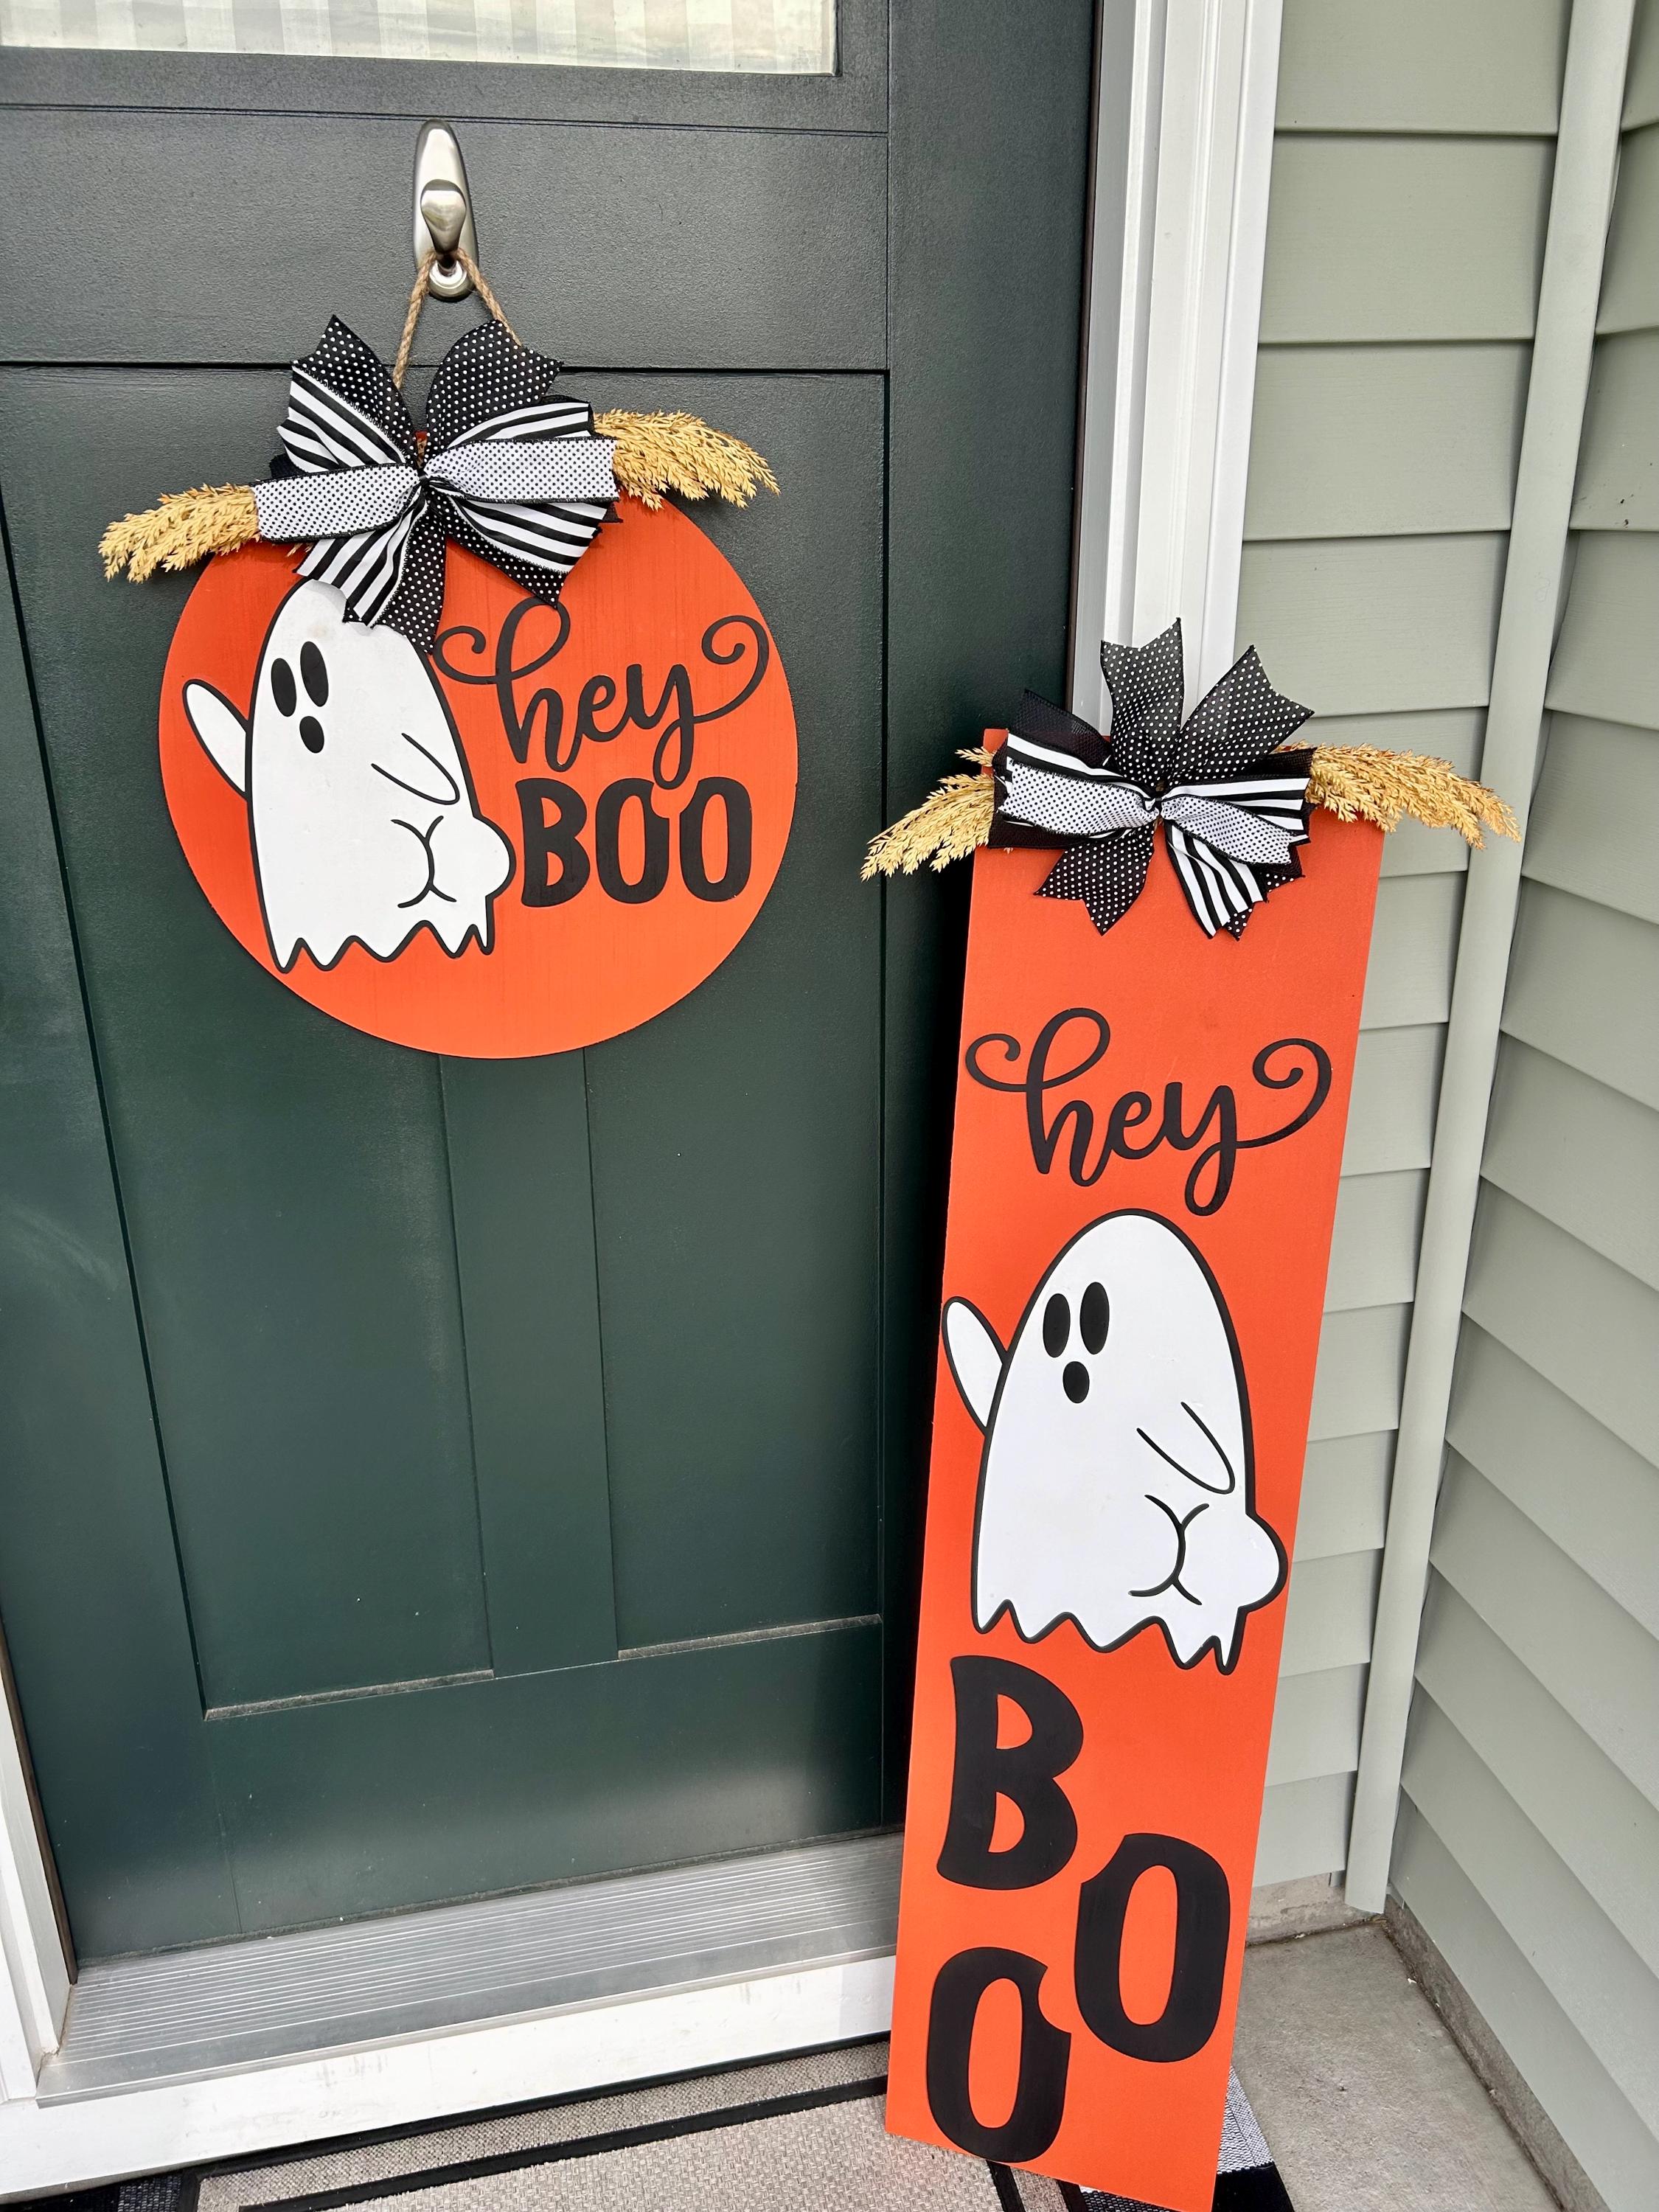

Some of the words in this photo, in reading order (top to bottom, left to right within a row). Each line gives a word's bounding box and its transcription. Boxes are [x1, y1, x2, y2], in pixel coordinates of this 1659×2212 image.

[434, 597, 769, 790] hey
[515, 776, 752, 908] BOO
[965, 1007, 1332, 1217] hey
